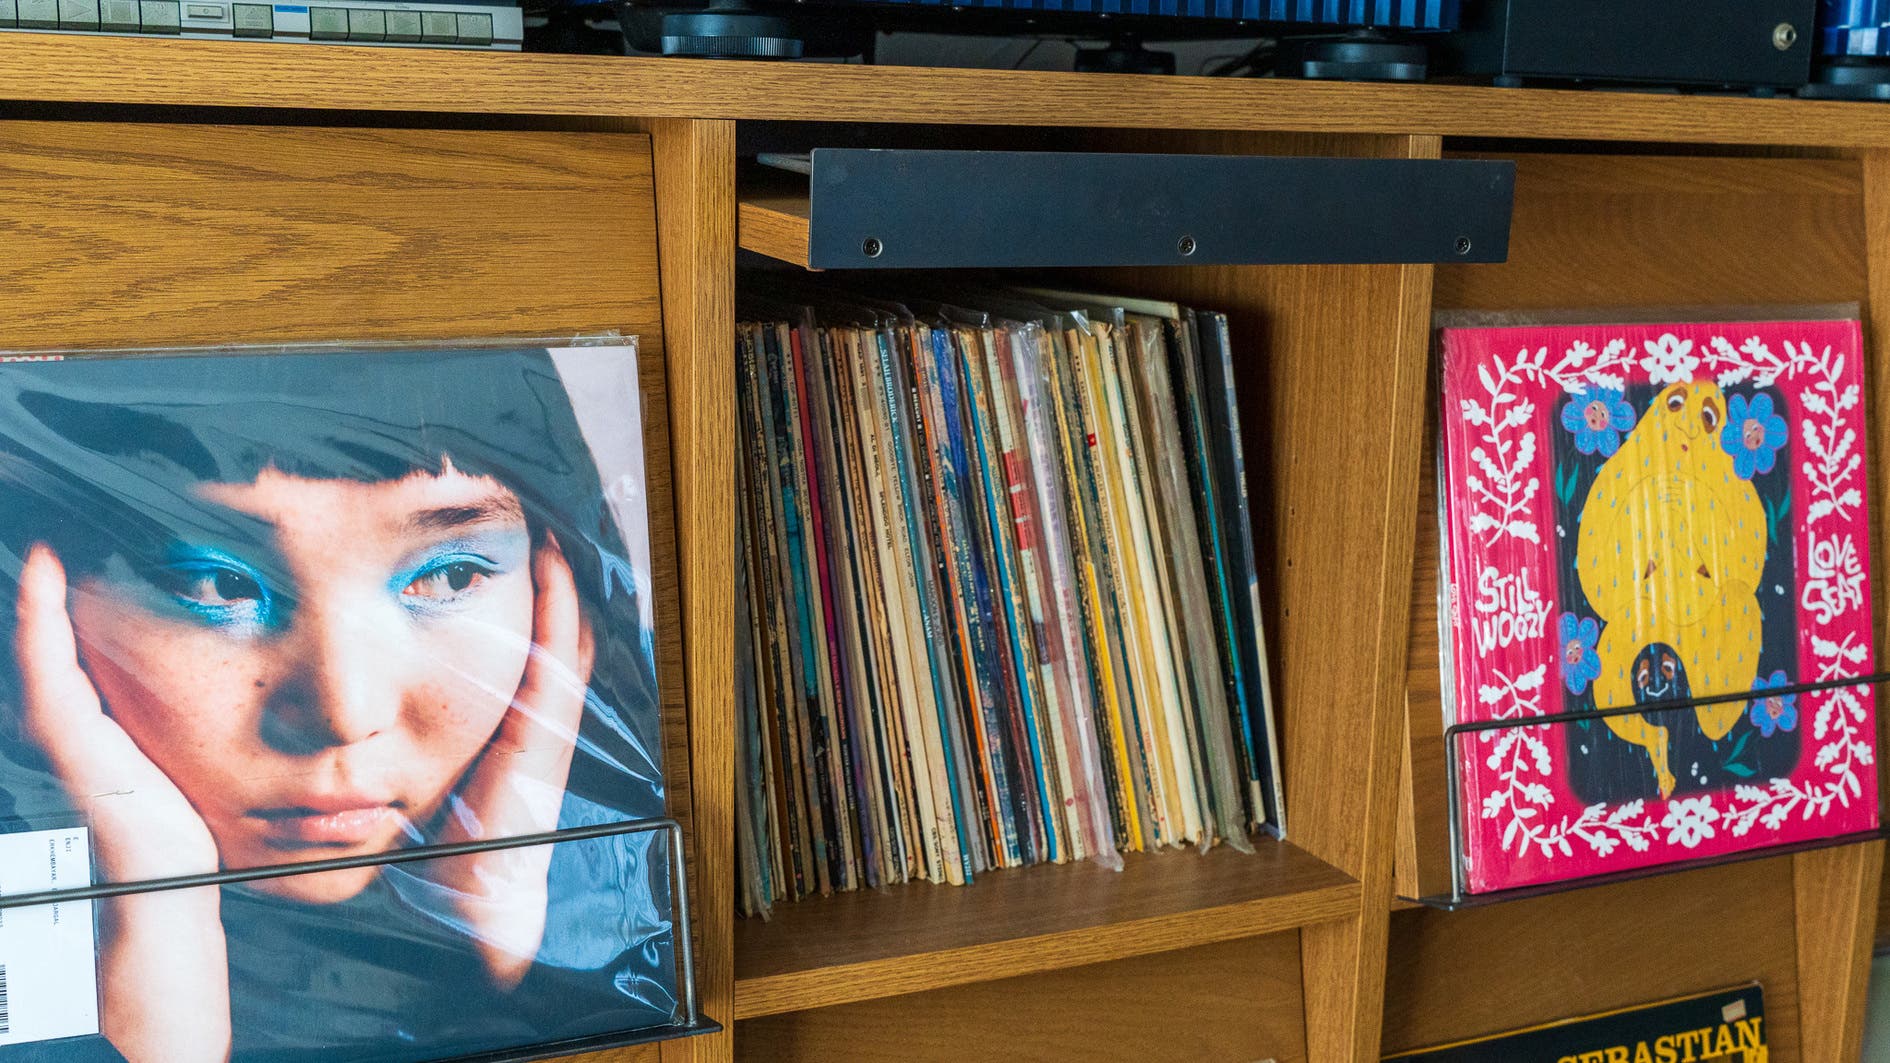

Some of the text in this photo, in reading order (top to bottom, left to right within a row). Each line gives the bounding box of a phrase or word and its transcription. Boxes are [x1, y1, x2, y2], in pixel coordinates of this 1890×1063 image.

[913, 393, 921, 422] MERCURY
[880, 349, 933, 638] SELAH BRODERICK ANAM
[893, 475, 901, 499] YELLOW
[885, 529, 893, 549] HOTEL
[1808, 531, 1862, 579] LOVE
[1802, 572, 1866, 625] SEAT
[1472, 600, 1553, 659] WOOZY
[1556, 1016, 1763, 1063] BASTIAN
